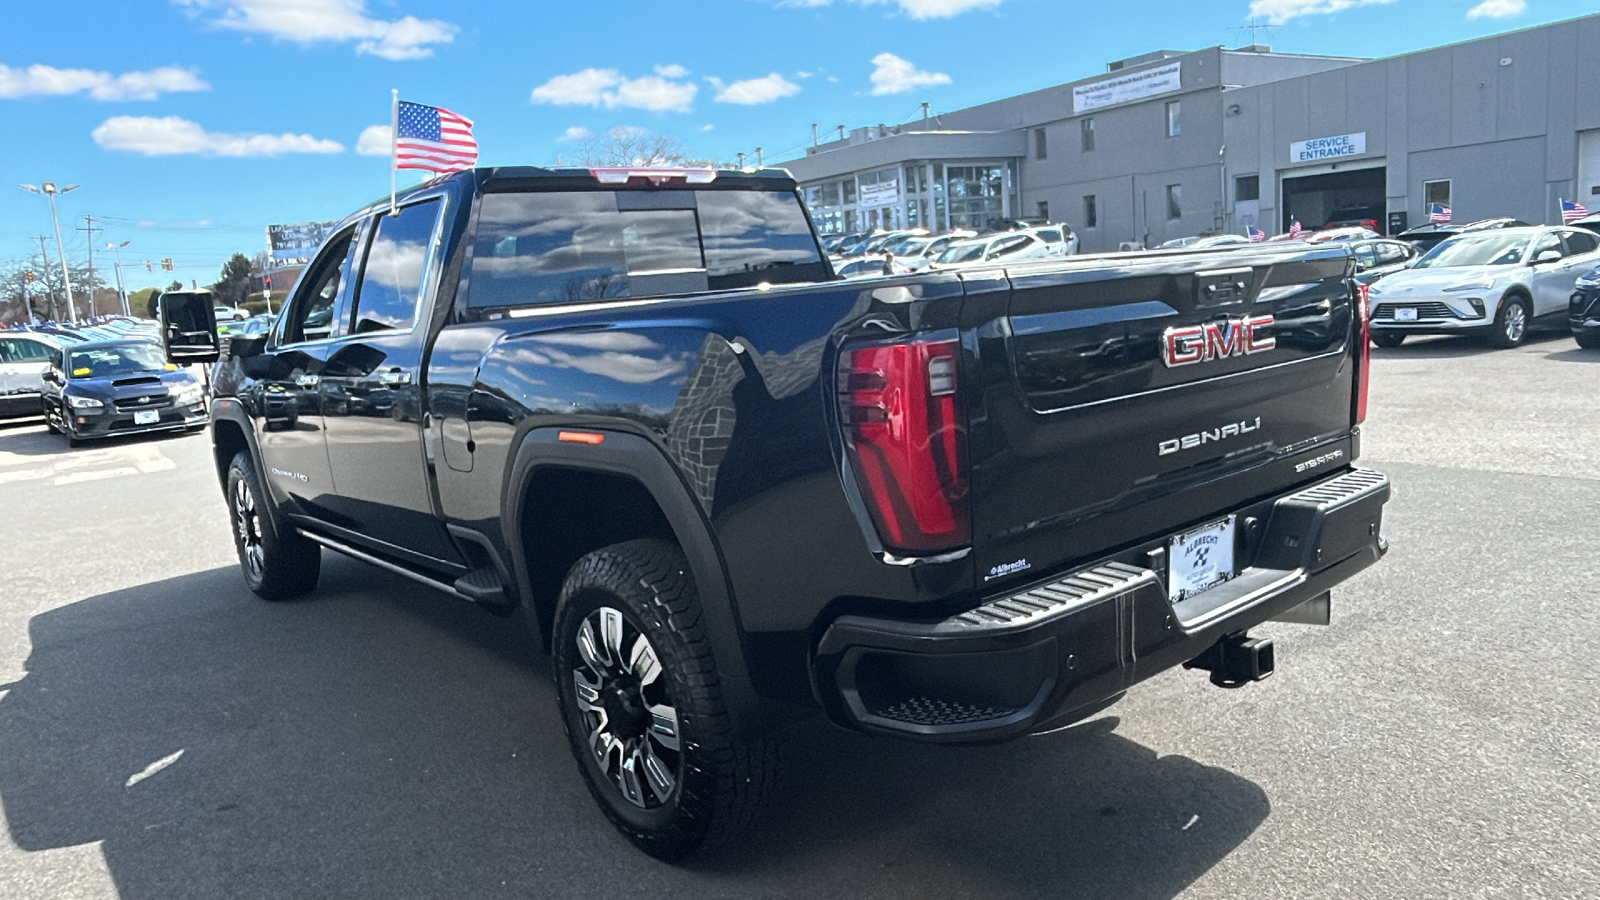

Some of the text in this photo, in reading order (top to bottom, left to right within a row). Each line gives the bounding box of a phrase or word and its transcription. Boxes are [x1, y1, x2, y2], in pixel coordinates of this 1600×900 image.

[1300, 145, 1355, 160] ENTRANCE
[1306, 136, 1349, 150] SERVICE
[1163, 315, 1276, 368] GMC
[1158, 416, 1261, 456] DENALI
[1294, 449, 1343, 473] SIERRA
[1184, 535, 1219, 557] ALBRECHT
